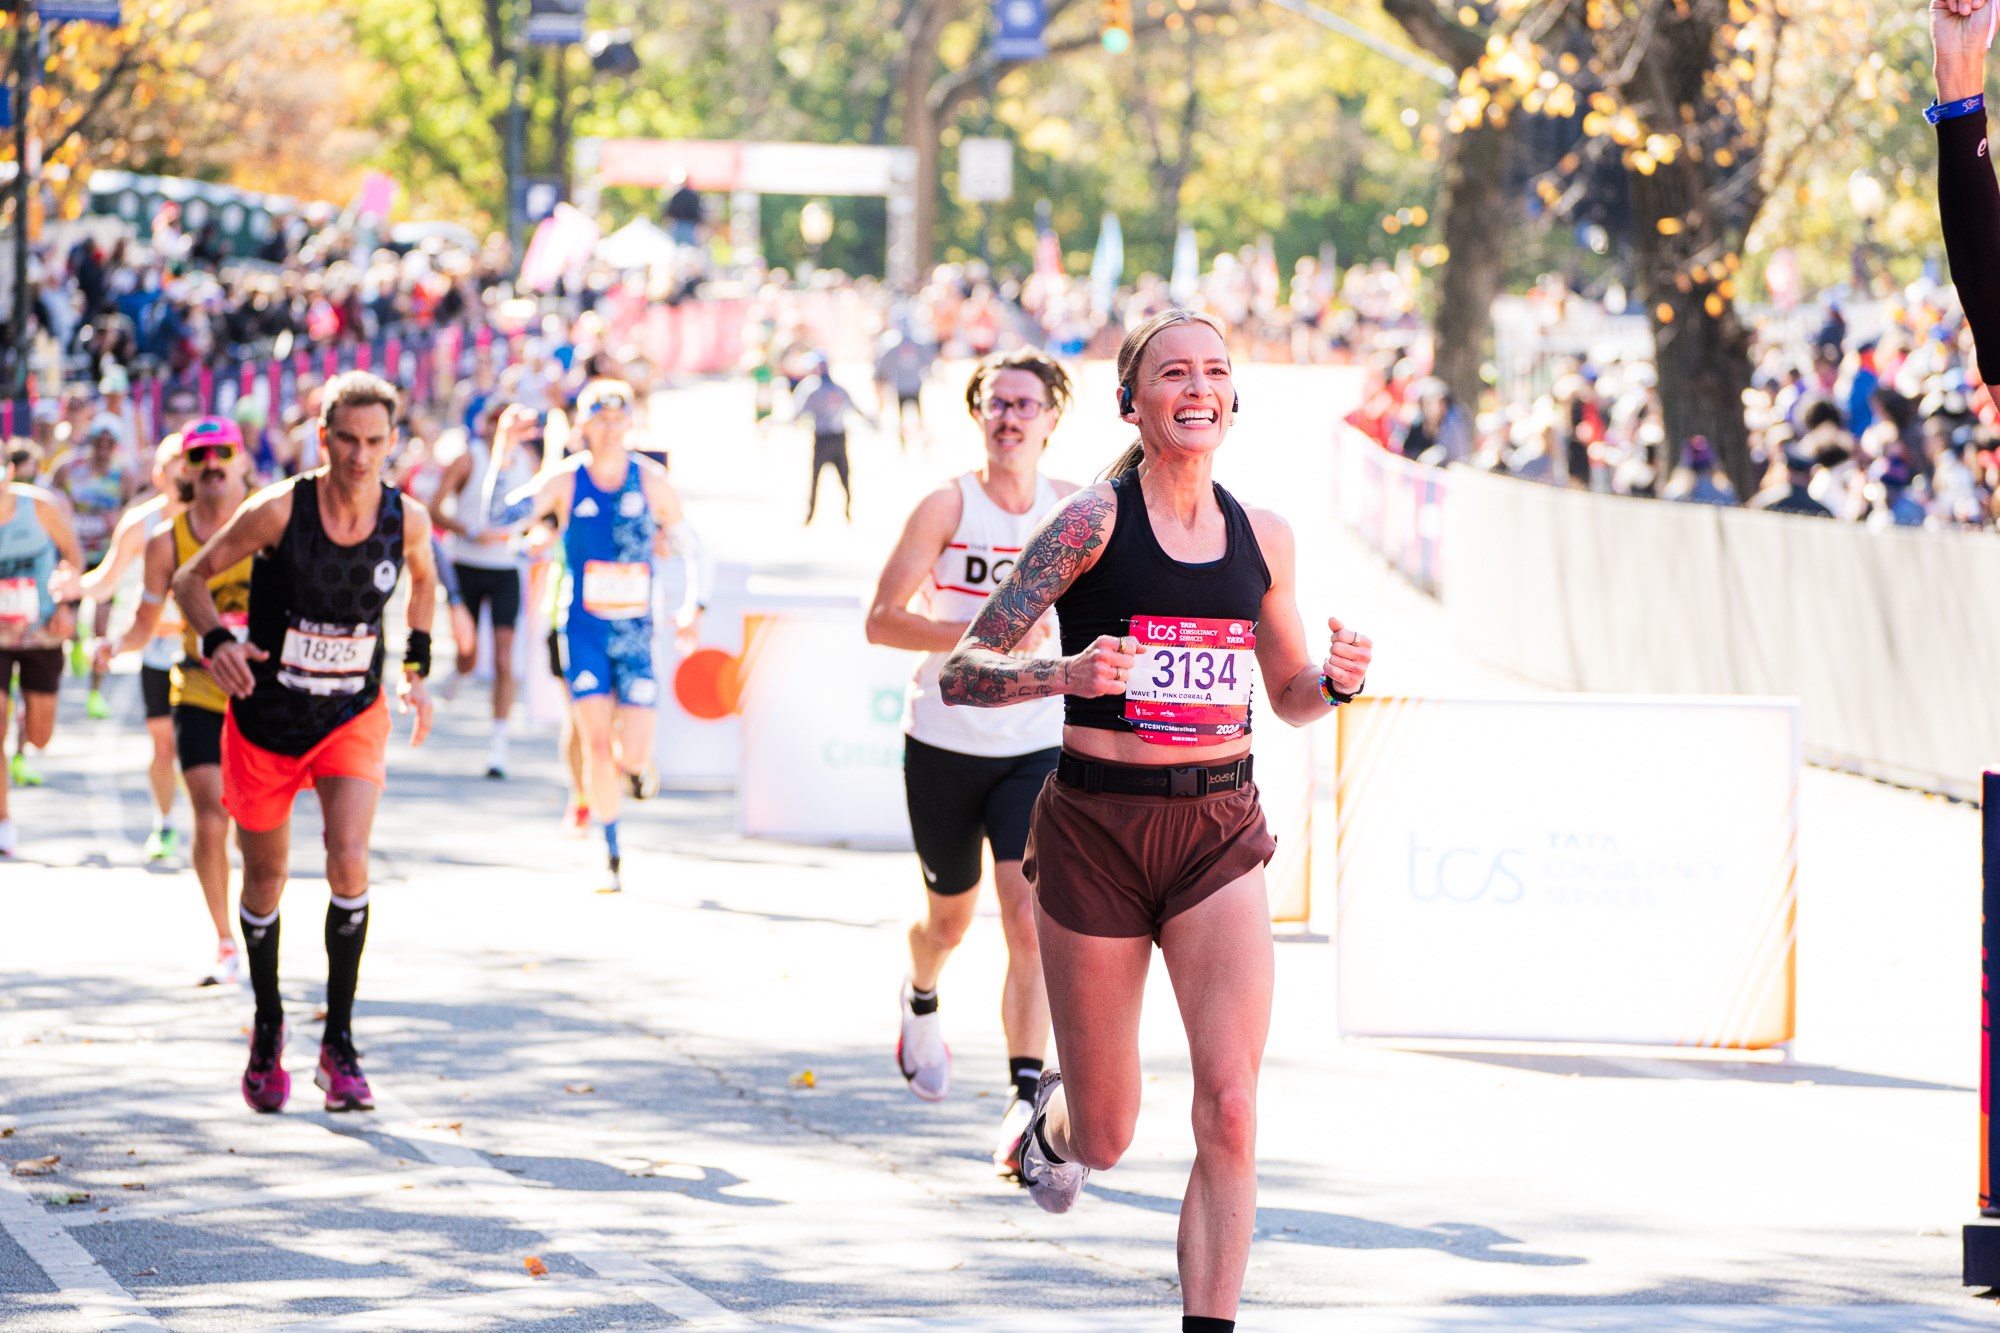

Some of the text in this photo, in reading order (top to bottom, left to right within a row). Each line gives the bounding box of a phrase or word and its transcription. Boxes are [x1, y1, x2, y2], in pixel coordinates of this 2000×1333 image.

[1147, 620, 1177, 641] tcs
[1226, 636, 1245, 644] TATA
[303, 639, 356, 662] 1825
[1152, 650, 1237, 690] 3134
[1130, 690, 1151, 698] WAVE
[1152, 690, 1157, 698] 1
[1205, 693, 1212, 701] A
[1140, 722, 1197, 733] #TCSNYCMarathon
[1547, 833, 1619, 850] TATA
[1408, 831, 1525, 904] tcs
